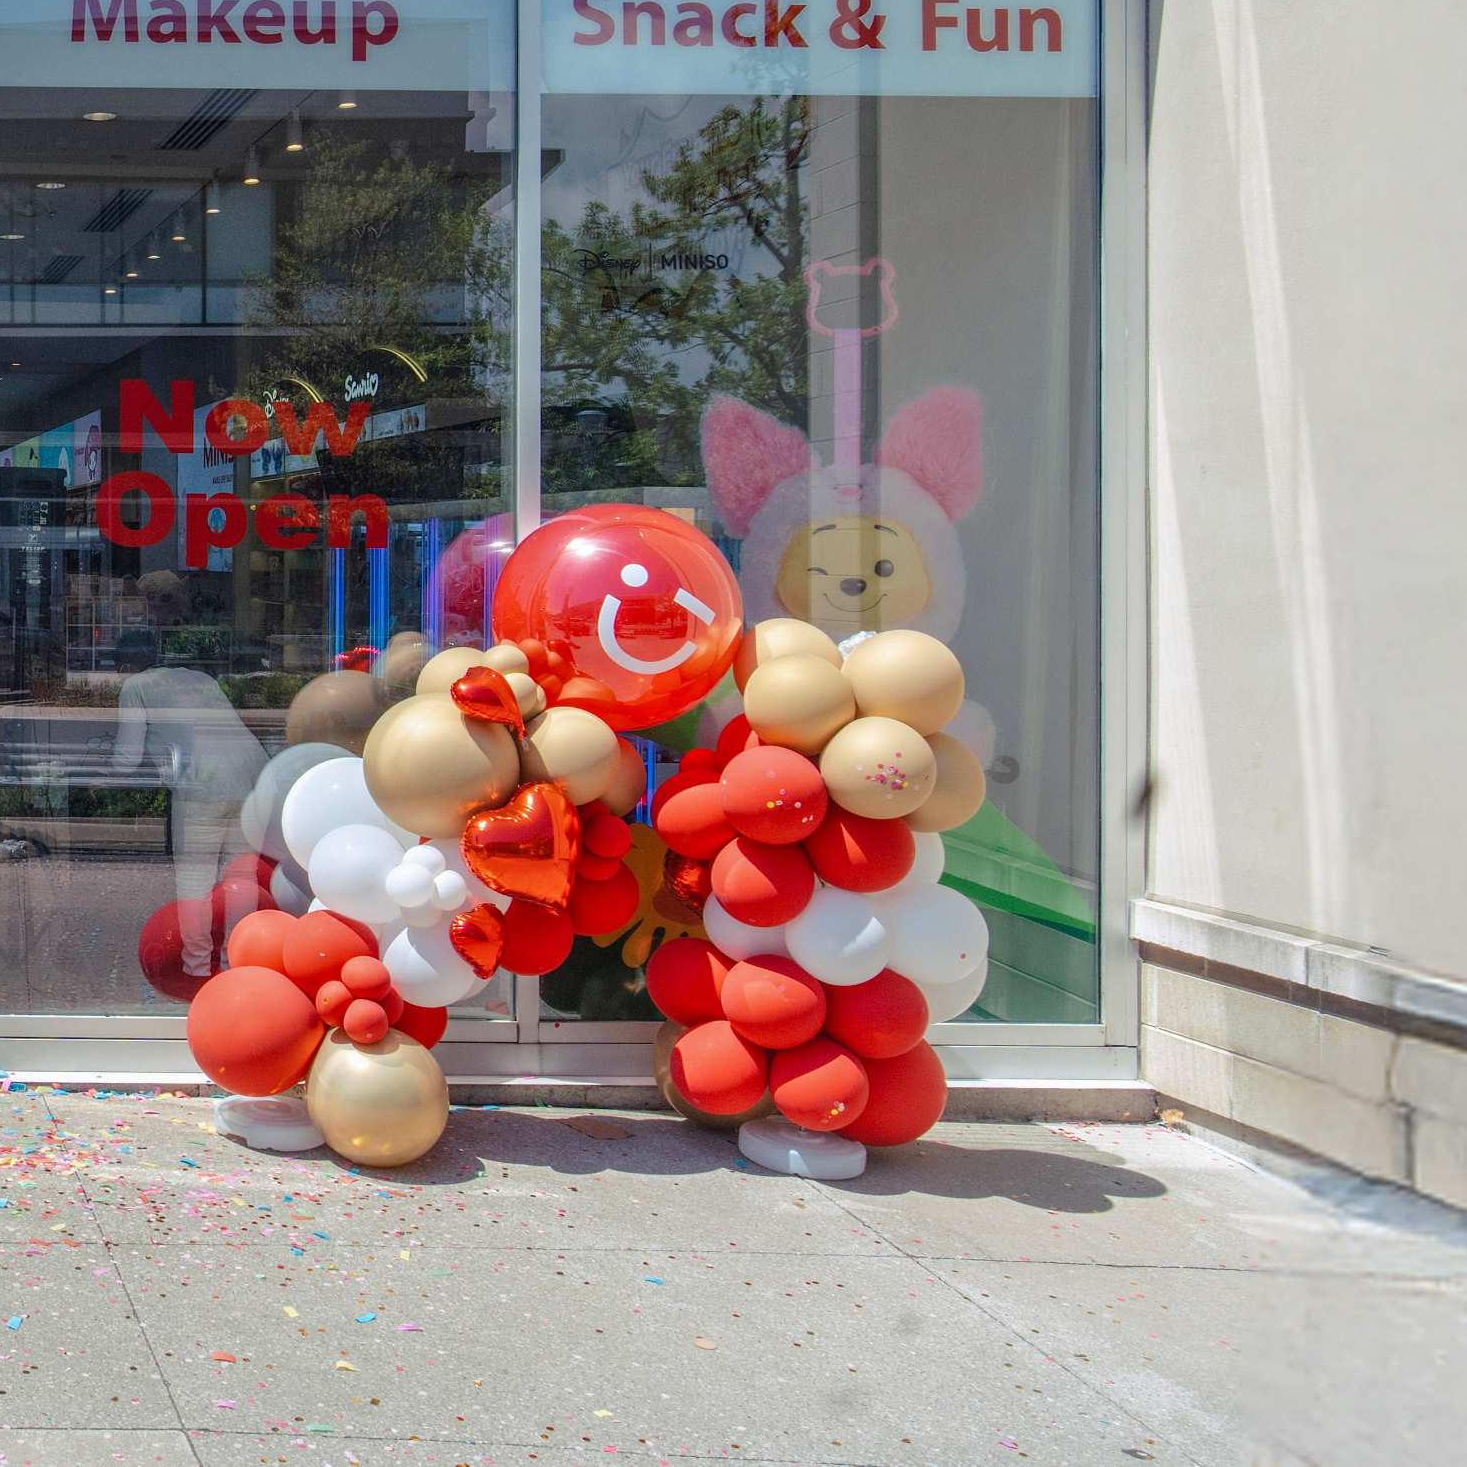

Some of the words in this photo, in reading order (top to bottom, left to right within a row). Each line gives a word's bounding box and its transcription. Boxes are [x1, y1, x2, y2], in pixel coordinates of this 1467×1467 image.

[660, 253, 729, 271] MINISO
[119, 378, 371, 458] Now
[94, 470, 389, 572] Open
